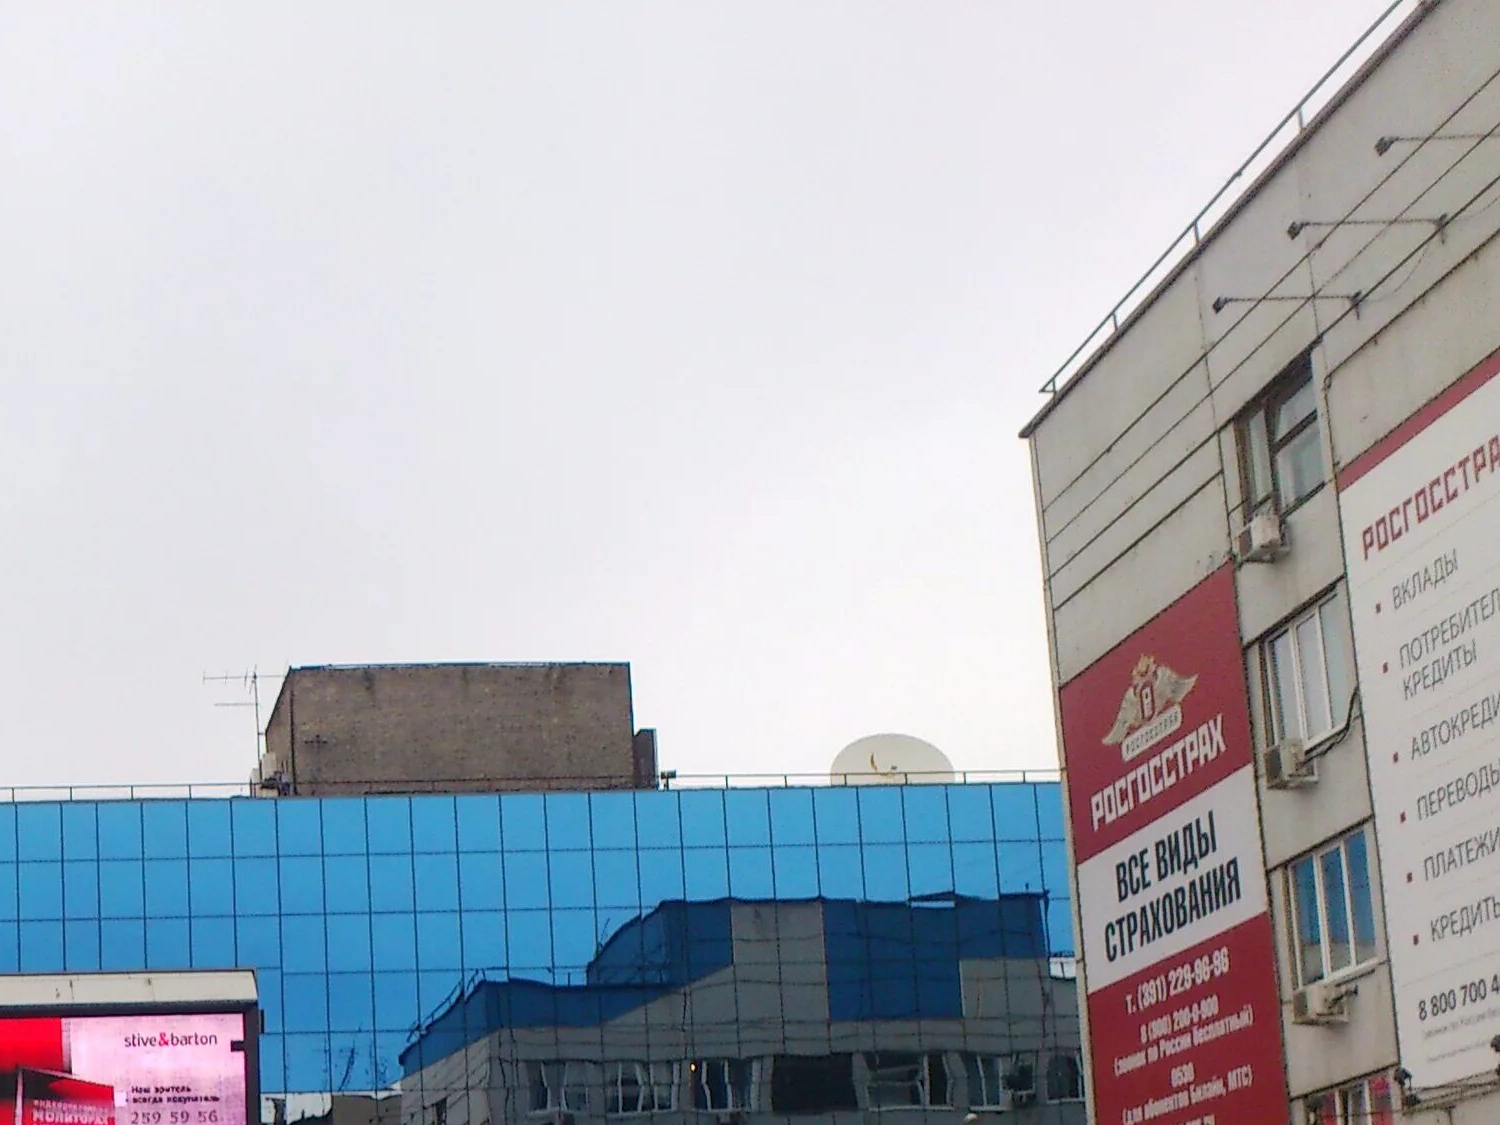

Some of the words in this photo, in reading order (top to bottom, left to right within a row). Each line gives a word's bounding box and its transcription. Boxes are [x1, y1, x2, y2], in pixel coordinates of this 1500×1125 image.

[1392, 548, 1459, 610] ВКЛАДЫ
[1403, 638, 1477, 701] КРЕДИТЫ
[1091, 713, 1227, 832] РОСГОССТРАХ
[1116, 848, 1151, 902] ВСЕ
[1155, 810, 1217, 882] ВИДЫ
[1424, 827, 1500, 881] ПЛАТЕЖИ
[1105, 856, 1241, 962] СТРАХОВАНИЯ
[1419, 1000, 1428, 1021] 8
[1431, 989, 1456, 1017] 800
[1460, 979, 1487, 1006] 700
[124, 1031, 218, 1048] stive&barton
[169, 1111, 190, 1124] 59
[197, 1111, 219, 1123] 56
